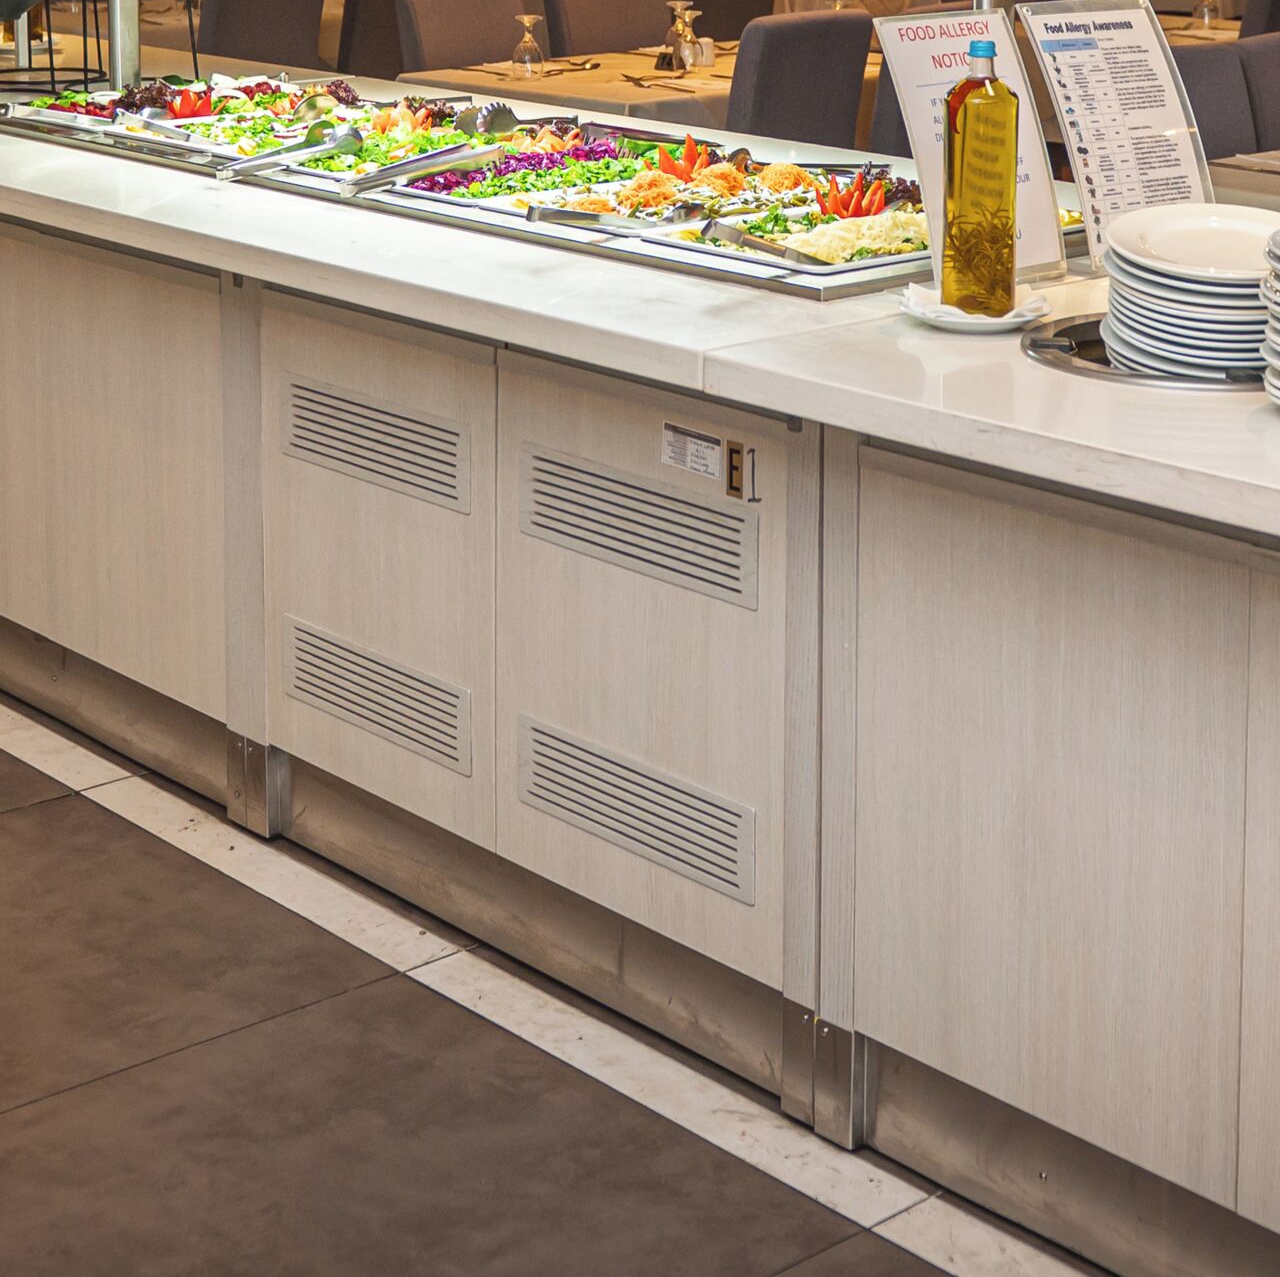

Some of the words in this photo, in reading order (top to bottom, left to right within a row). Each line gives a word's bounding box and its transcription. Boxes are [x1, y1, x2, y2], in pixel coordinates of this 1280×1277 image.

[898, 25, 936, 42] FOOD
[939, 21, 990, 39] ALLERGY
[1043, 22, 1064, 35] Food
[1065, 21, 1092, 35] Allergy
[1093, 19, 1134, 33] Awareness
[932, 52, 971, 69] NOTIC
[1015, 173, 1031, 184] OUR
